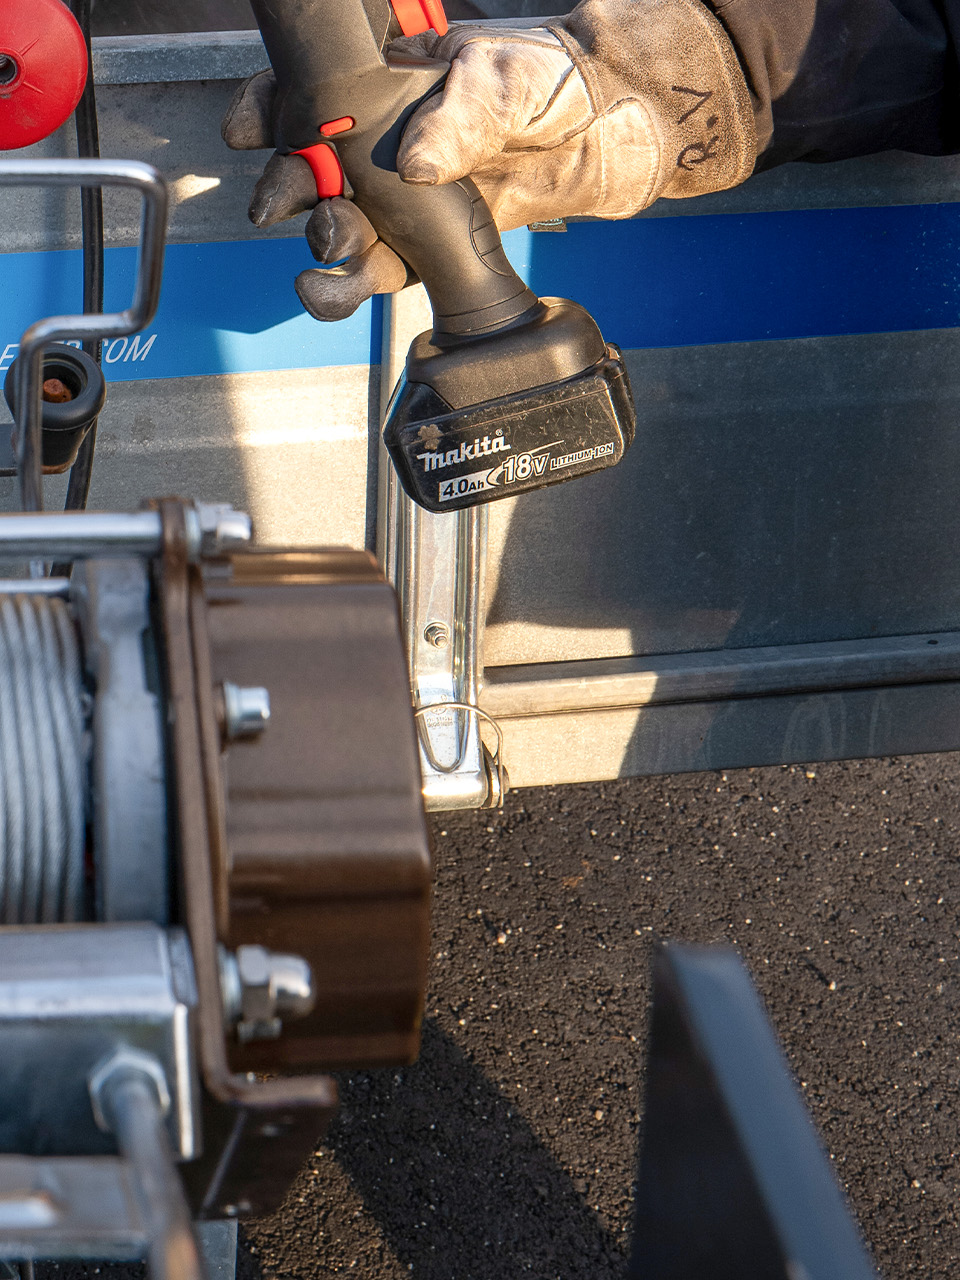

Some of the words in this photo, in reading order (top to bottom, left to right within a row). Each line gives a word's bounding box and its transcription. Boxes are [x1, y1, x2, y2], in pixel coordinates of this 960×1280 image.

[442, 478, 485, 498] 4.0Ah
[502, 452, 551, 485] 18V
[550, 443, 614, 470] LITHIUM-ION
